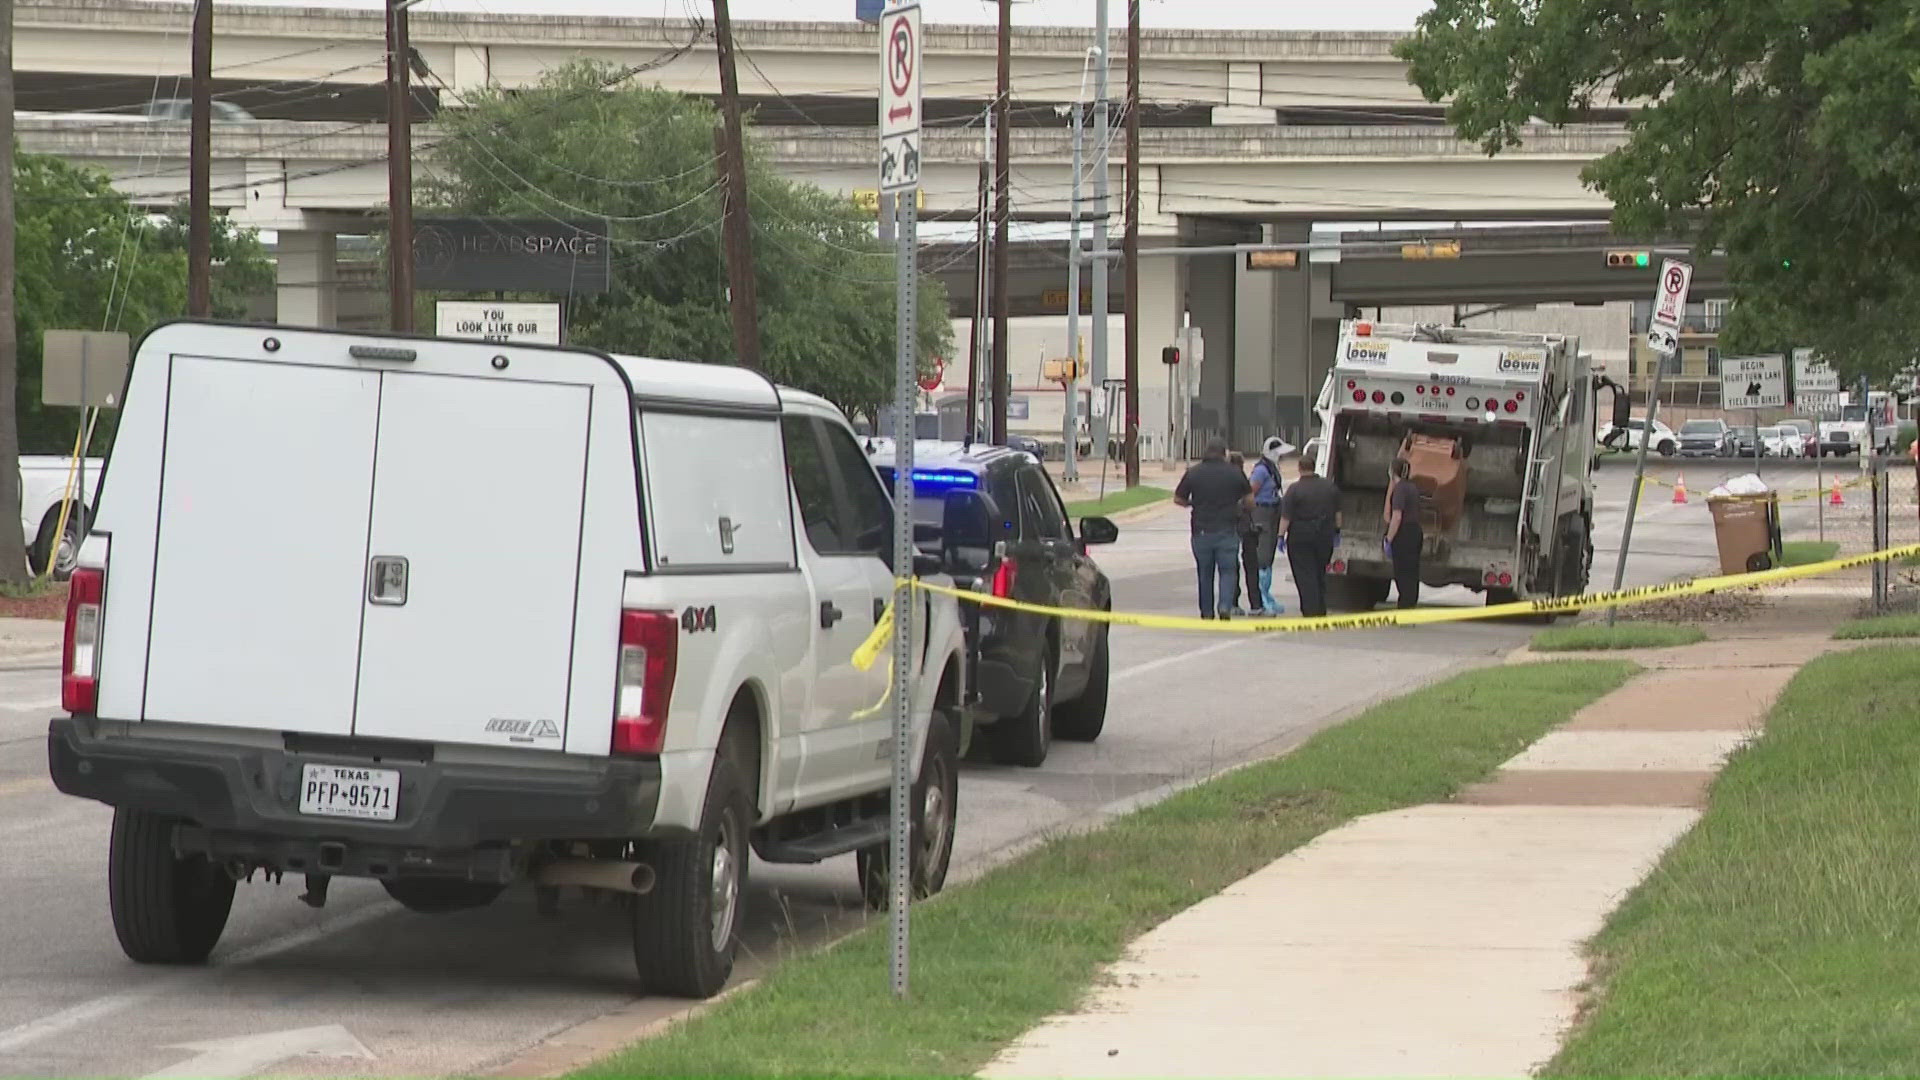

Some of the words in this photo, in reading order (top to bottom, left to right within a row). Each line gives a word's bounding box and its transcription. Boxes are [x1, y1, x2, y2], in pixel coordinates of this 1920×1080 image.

[463, 234, 598, 254] HEADSPACE
[483, 310, 504, 320] YOU
[456, 322, 482, 333] LOOK
[488, 323, 513, 333] LIKE
[517, 324, 537, 334] OUR
[1351, 349, 1387, 360] DOWN
[1503, 360, 1539, 370] DOWN
[1740, 361, 1764, 370] BEGIN
[1804, 366, 1827, 374] MUST
[1724, 373, 1743, 383] RIGHT
[1745, 372, 1762, 381] TURN
[1764, 370, 1781, 379] LANE
[1797, 380, 1814, 388] TURN
[1816, 379, 1836, 387] RIGHT
[1728, 397, 1748, 406] YIELD
[1750, 396, 1759, 405] TO
[1761, 394, 1780, 404] BIKES
[334, 769, 370, 780] TEXAS
